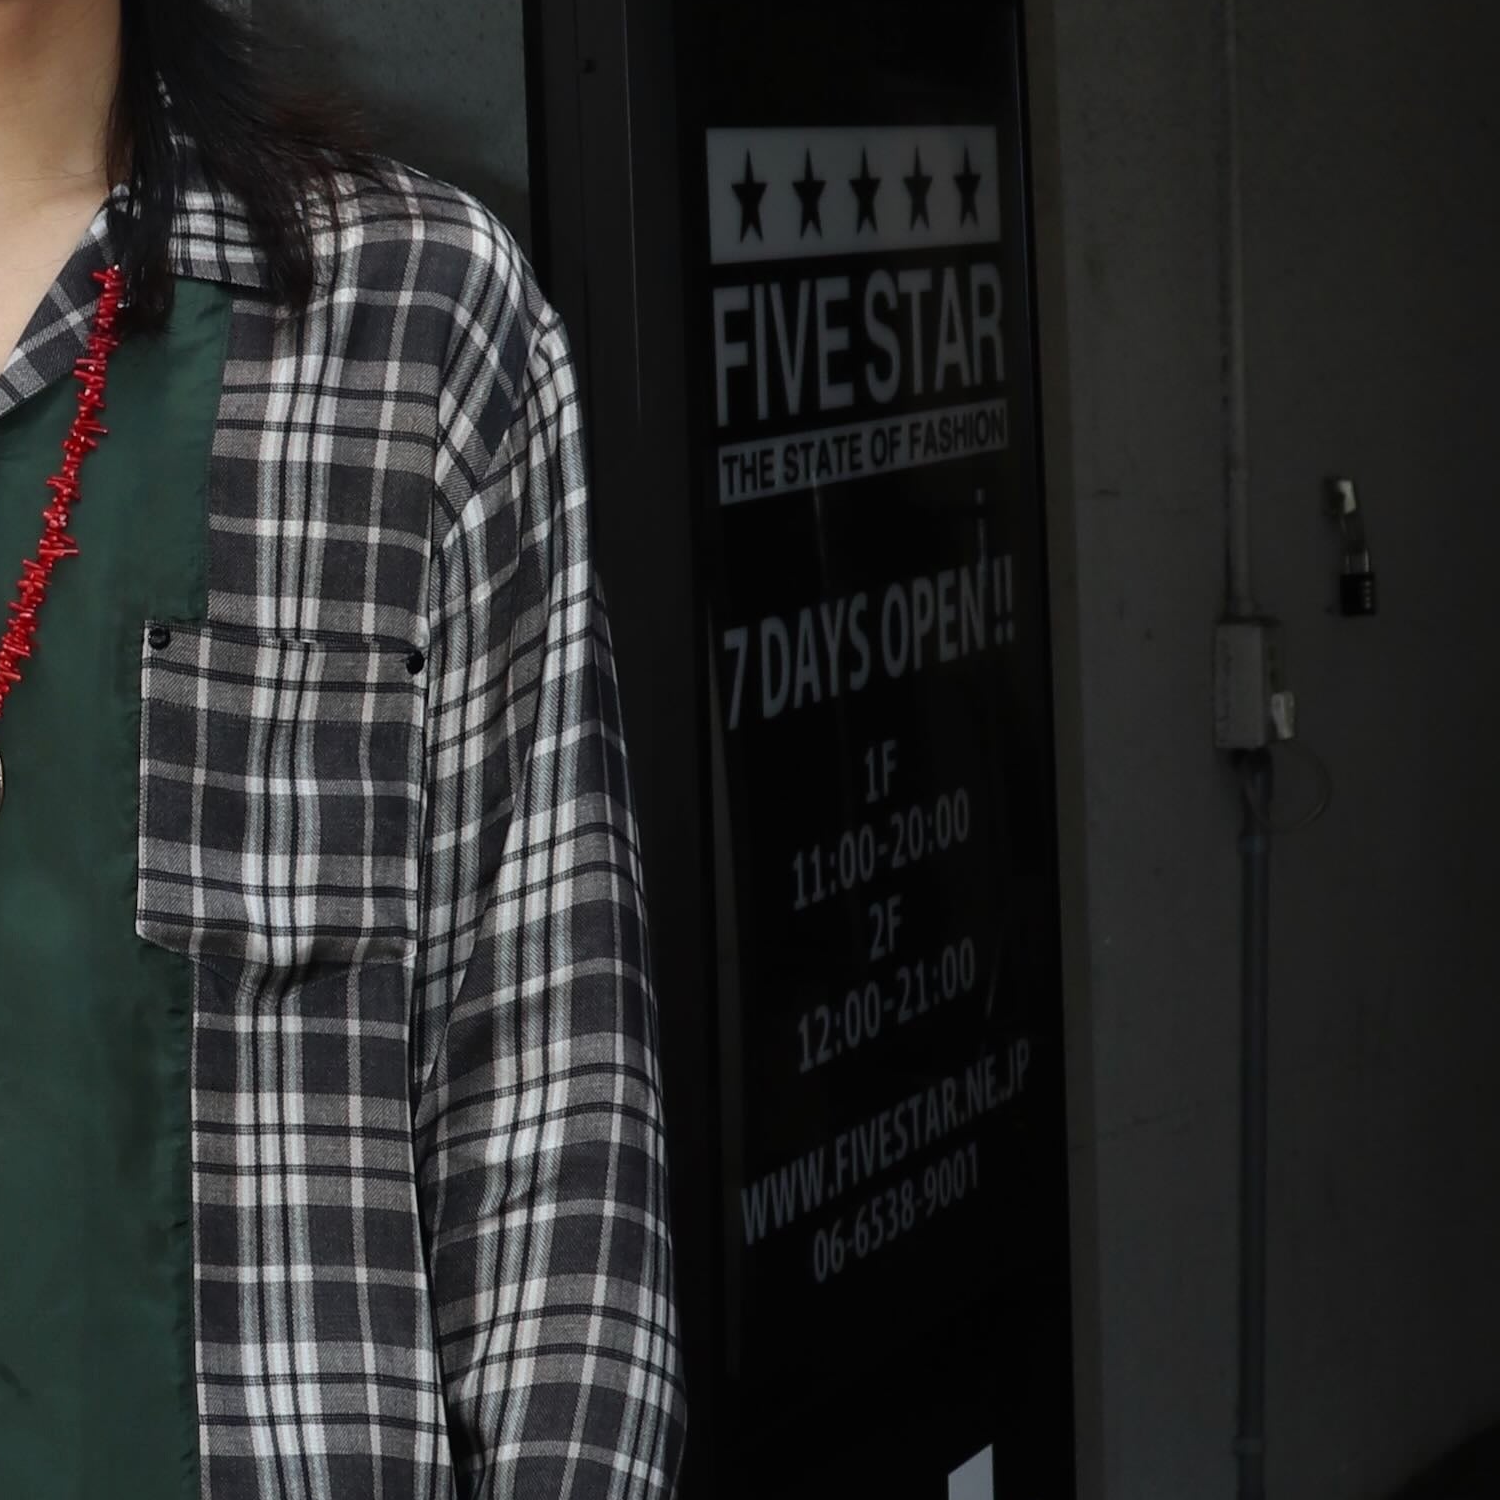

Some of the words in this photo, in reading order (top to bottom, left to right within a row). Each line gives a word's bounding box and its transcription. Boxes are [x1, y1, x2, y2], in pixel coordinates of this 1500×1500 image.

[722, 445, 775, 496] THE
[784, 432, 863, 484] STATE
[871, 424, 902, 467] OF
[910, 407, 1004, 459] FASHION
[724, 625, 749, 731] 7
[759, 590, 871, 720] DAYS
[864, 739, 898, 804] 1F
[792, 786, 970, 911] 11:00-20:00
[868, 895, 903, 962] 2F
[798, 936, 976, 1075] 12:00-21:00
[740, 1037, 1030, 1246] WWW.FIVESTAR.NE.JP
[813, 1140, 979, 1284] 06-6538-9001
